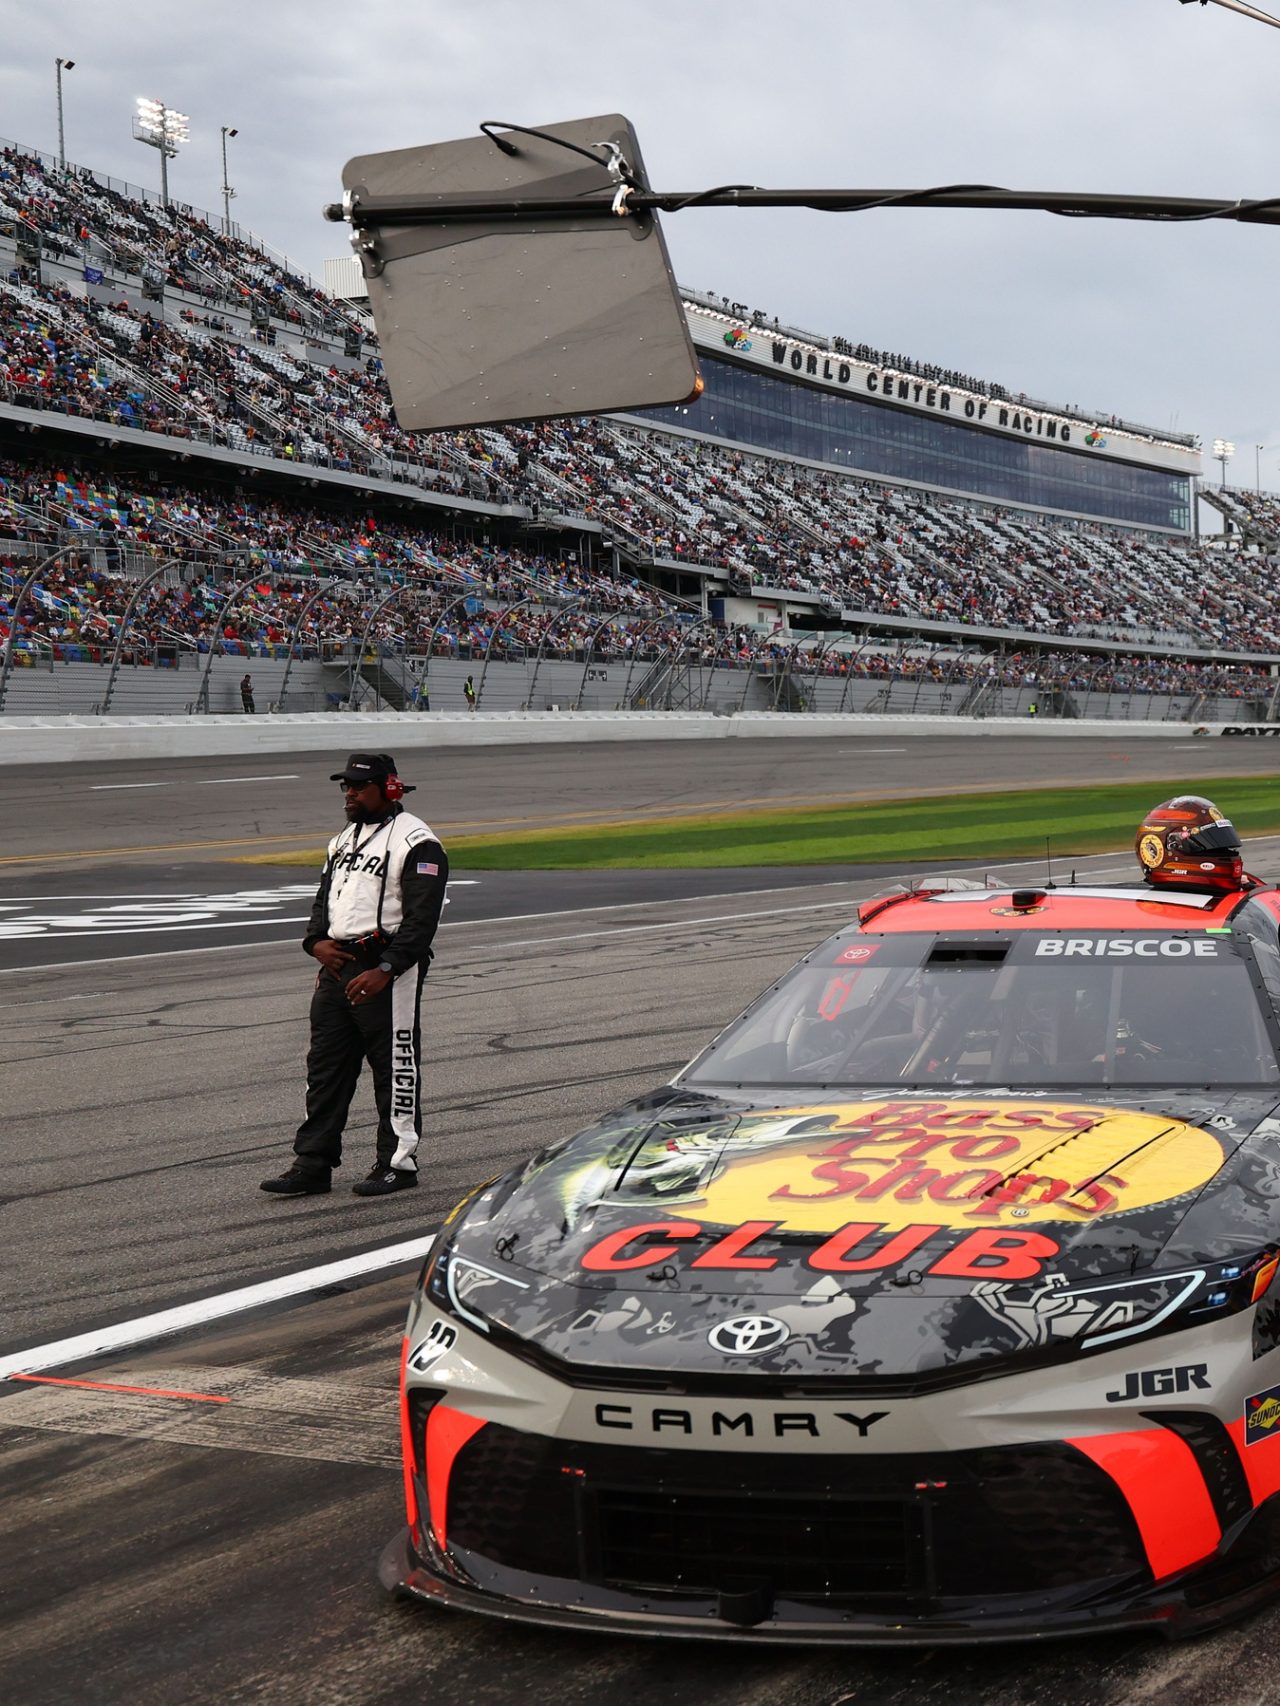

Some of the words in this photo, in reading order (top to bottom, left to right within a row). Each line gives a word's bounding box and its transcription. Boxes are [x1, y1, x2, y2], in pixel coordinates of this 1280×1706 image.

[772, 341, 851, 384] WORLD
[867, 371, 951, 411] CENTER
[965, 399, 988, 420] OF
[999, 408, 1071, 442] RACING
[1035, 939, 1218, 957] BRISCOE
[394, 1029, 415, 1118] OFFICIAL
[838, 1103, 1106, 1132] Bass
[809, 1127, 1019, 1163] Pro
[768, 1157, 1129, 1218] Shops
[580, 1220, 1062, 1280] CLUB
[1106, 1363, 1212, 1402] JGR
[594, 1403, 891, 1437] CAMRY
